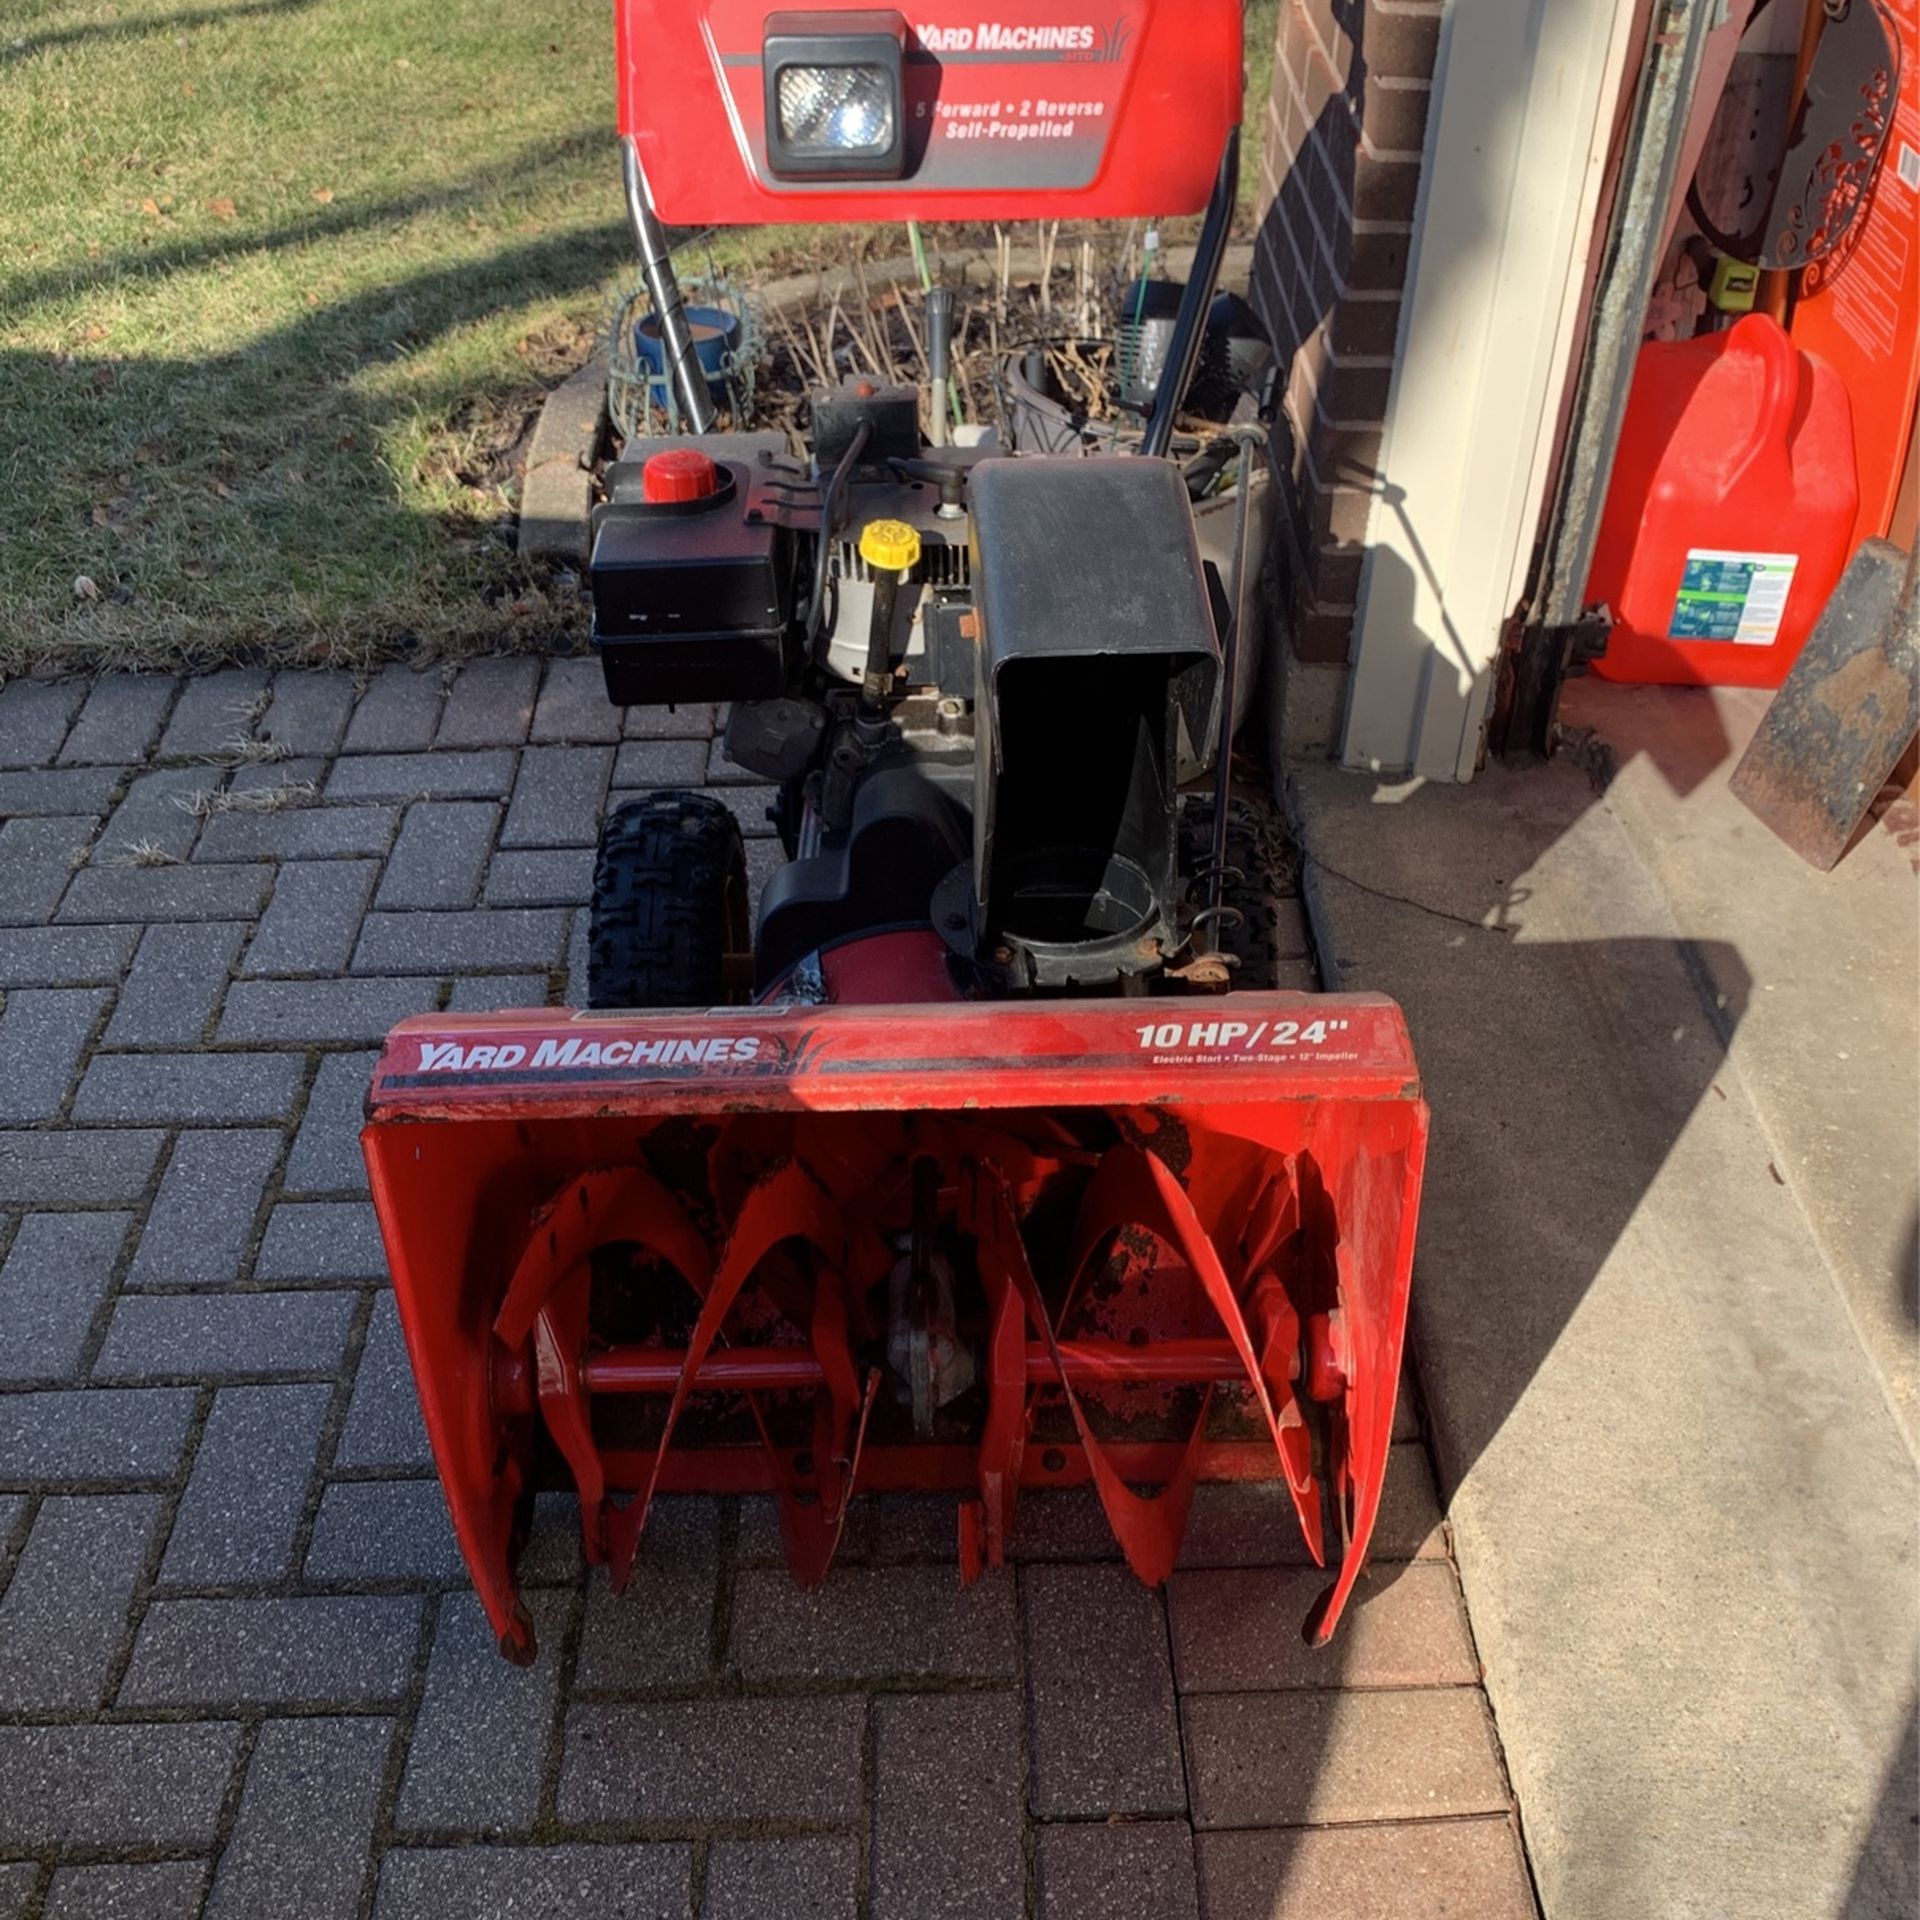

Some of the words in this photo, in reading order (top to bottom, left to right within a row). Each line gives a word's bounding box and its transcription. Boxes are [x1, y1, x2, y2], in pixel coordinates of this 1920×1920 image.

[916, 24, 972, 50] YARD
[976, 23, 1094, 50] MACHINES
[915, 102, 926, 117] 5
[1019, 100, 1031, 117] 2
[1036, 100, 1104, 116] Reverse
[946, 121, 1074, 140] Self-Propelled
[1135, 1023, 1183, 1048] 10
[417, 1042, 526, 1071] YARD
[529, 1038, 760, 1067] MACHINES
[1153, 1055, 1193, 1064] Electric
[1195, 1054, 1222, 1063] Start
[1233, 1053, 1287, 1063] Two-Stage
[1316, 1052, 1359, 1061] Impeller
